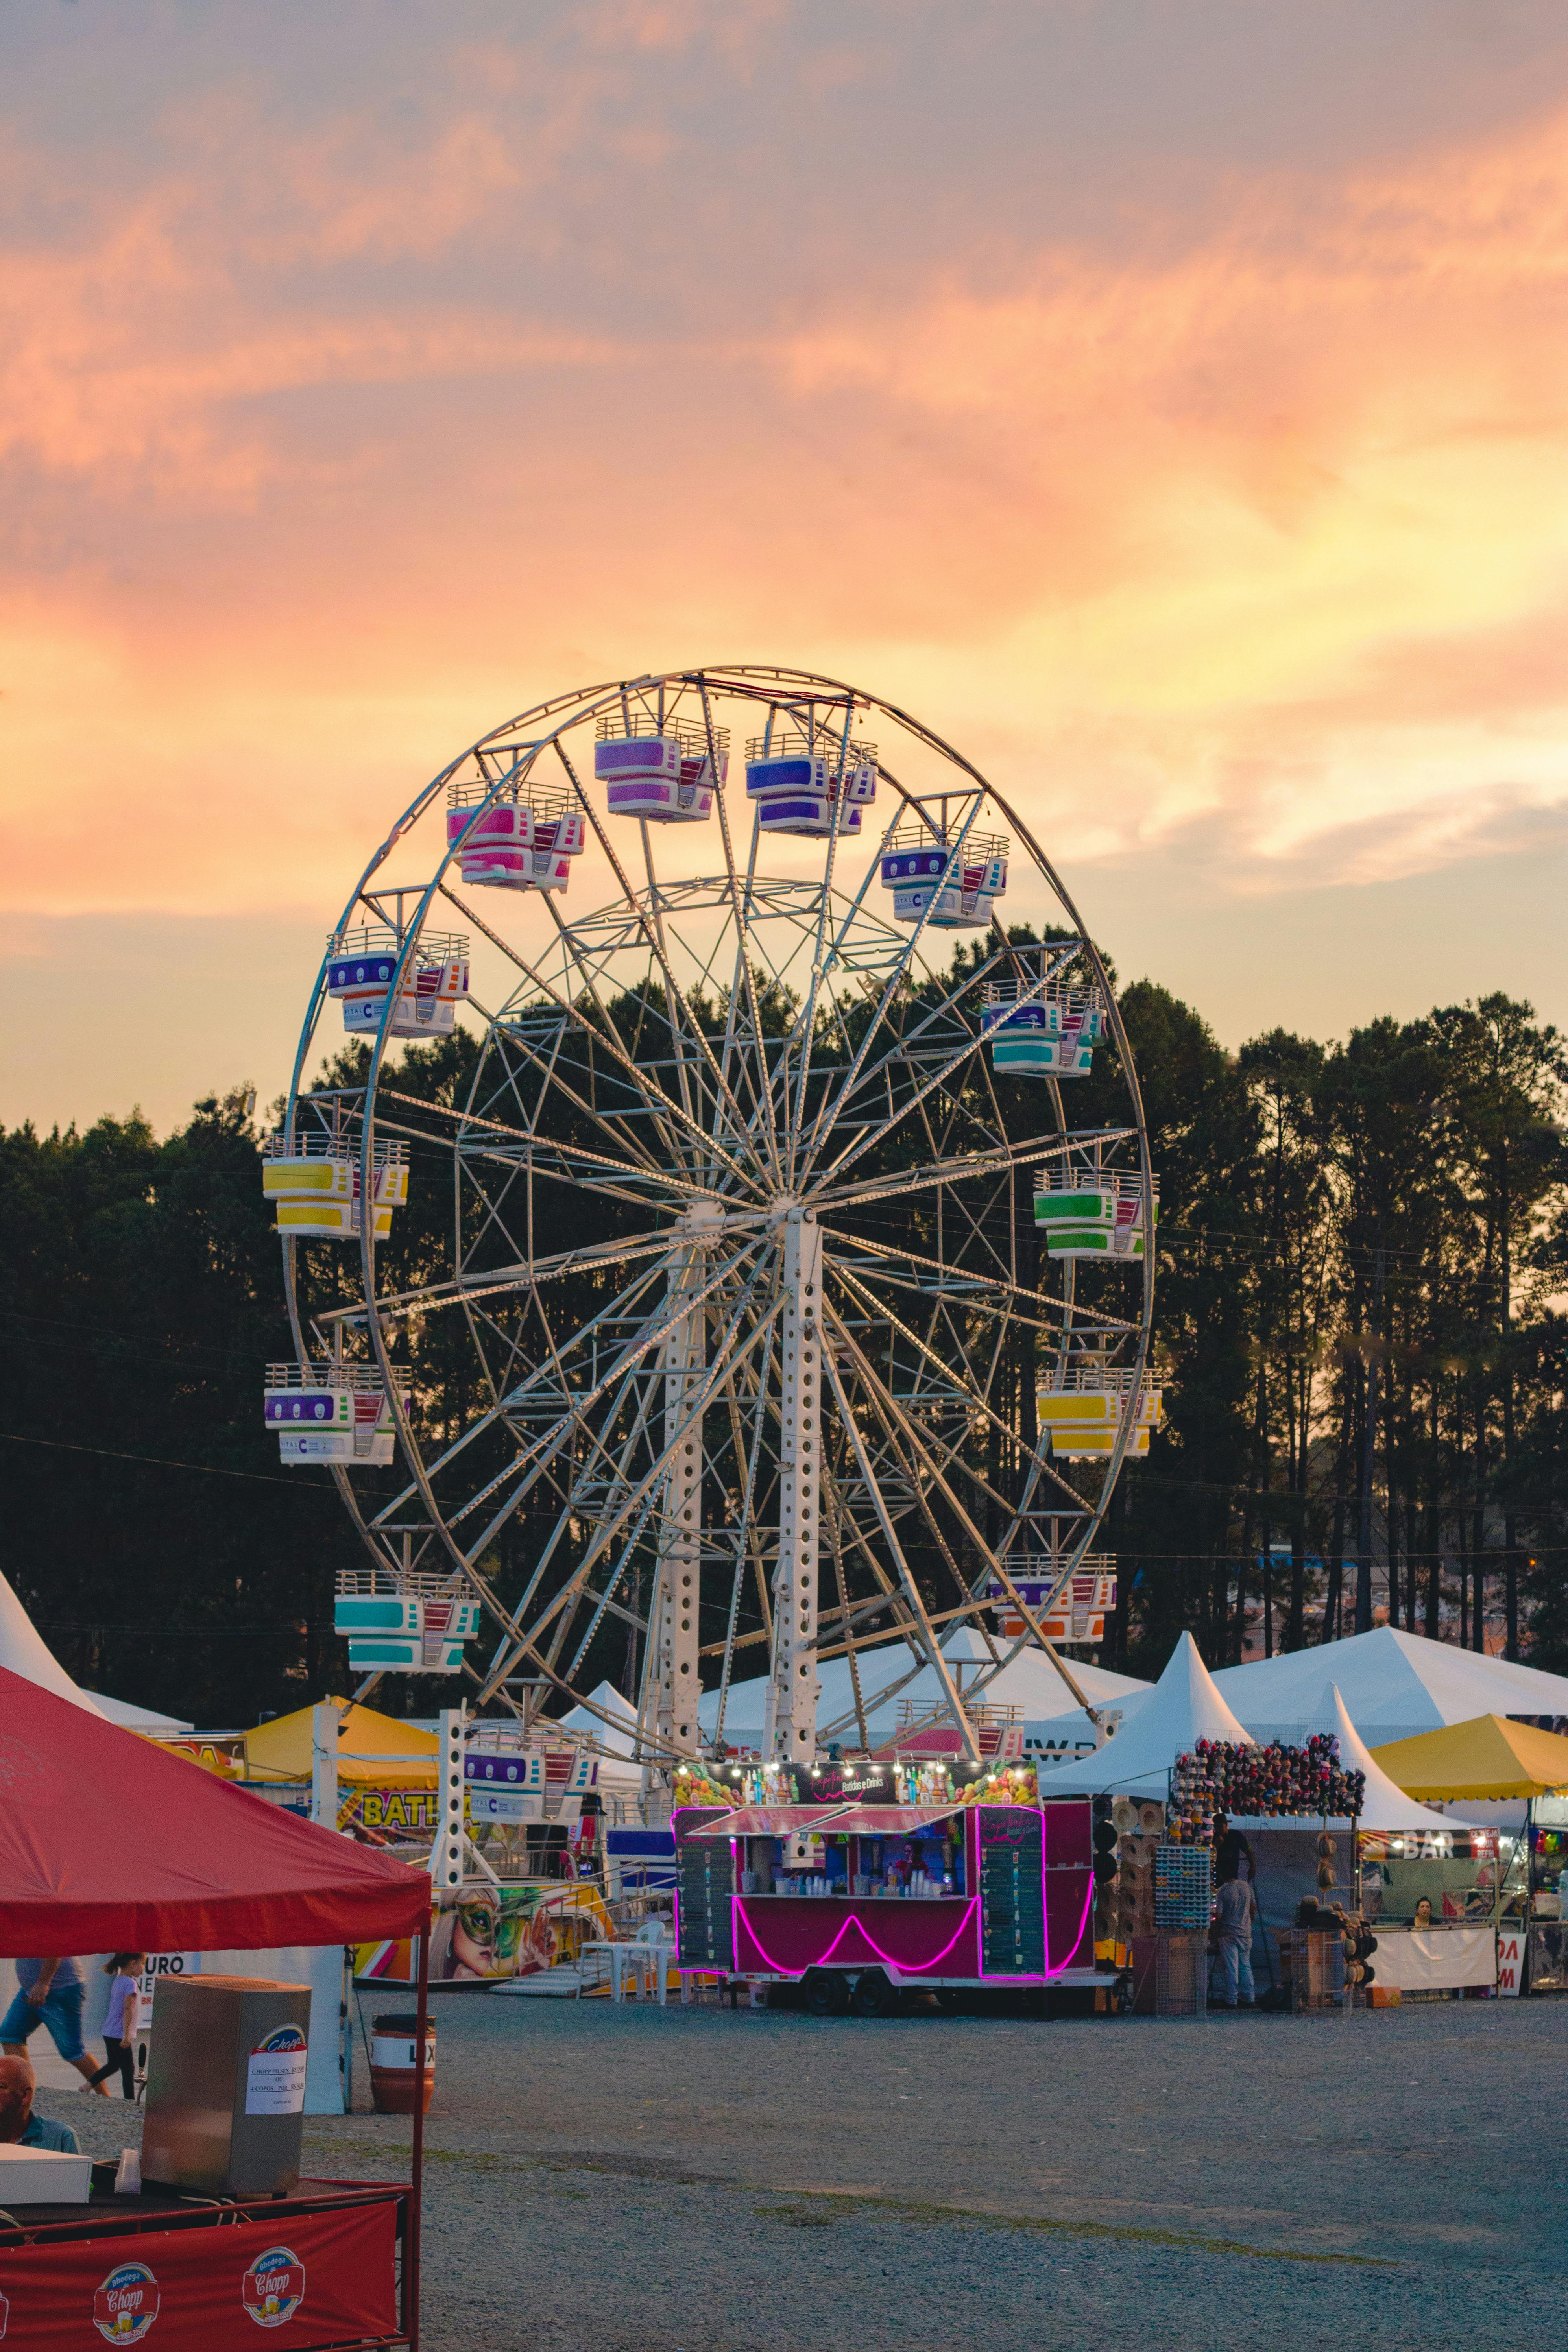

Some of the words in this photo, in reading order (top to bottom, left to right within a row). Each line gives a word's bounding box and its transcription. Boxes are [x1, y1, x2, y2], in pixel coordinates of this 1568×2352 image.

[842, 1780, 861, 1792] Batidas
[866, 1776, 883, 1789] Drinks
[363, 1794, 480, 1827] BATIA
[1403, 1830, 1454, 1859] BAR
[1477, 1850, 1494, 1859] REFRI
[267, 2037, 302, 2053] Chopp
[259, 2257, 286, 2271] Bhodega
[112, 2273, 140, 2287] Bhodega
[255, 2272, 289, 2295] Chopp
[107, 2289, 143, 2312] Chopp
